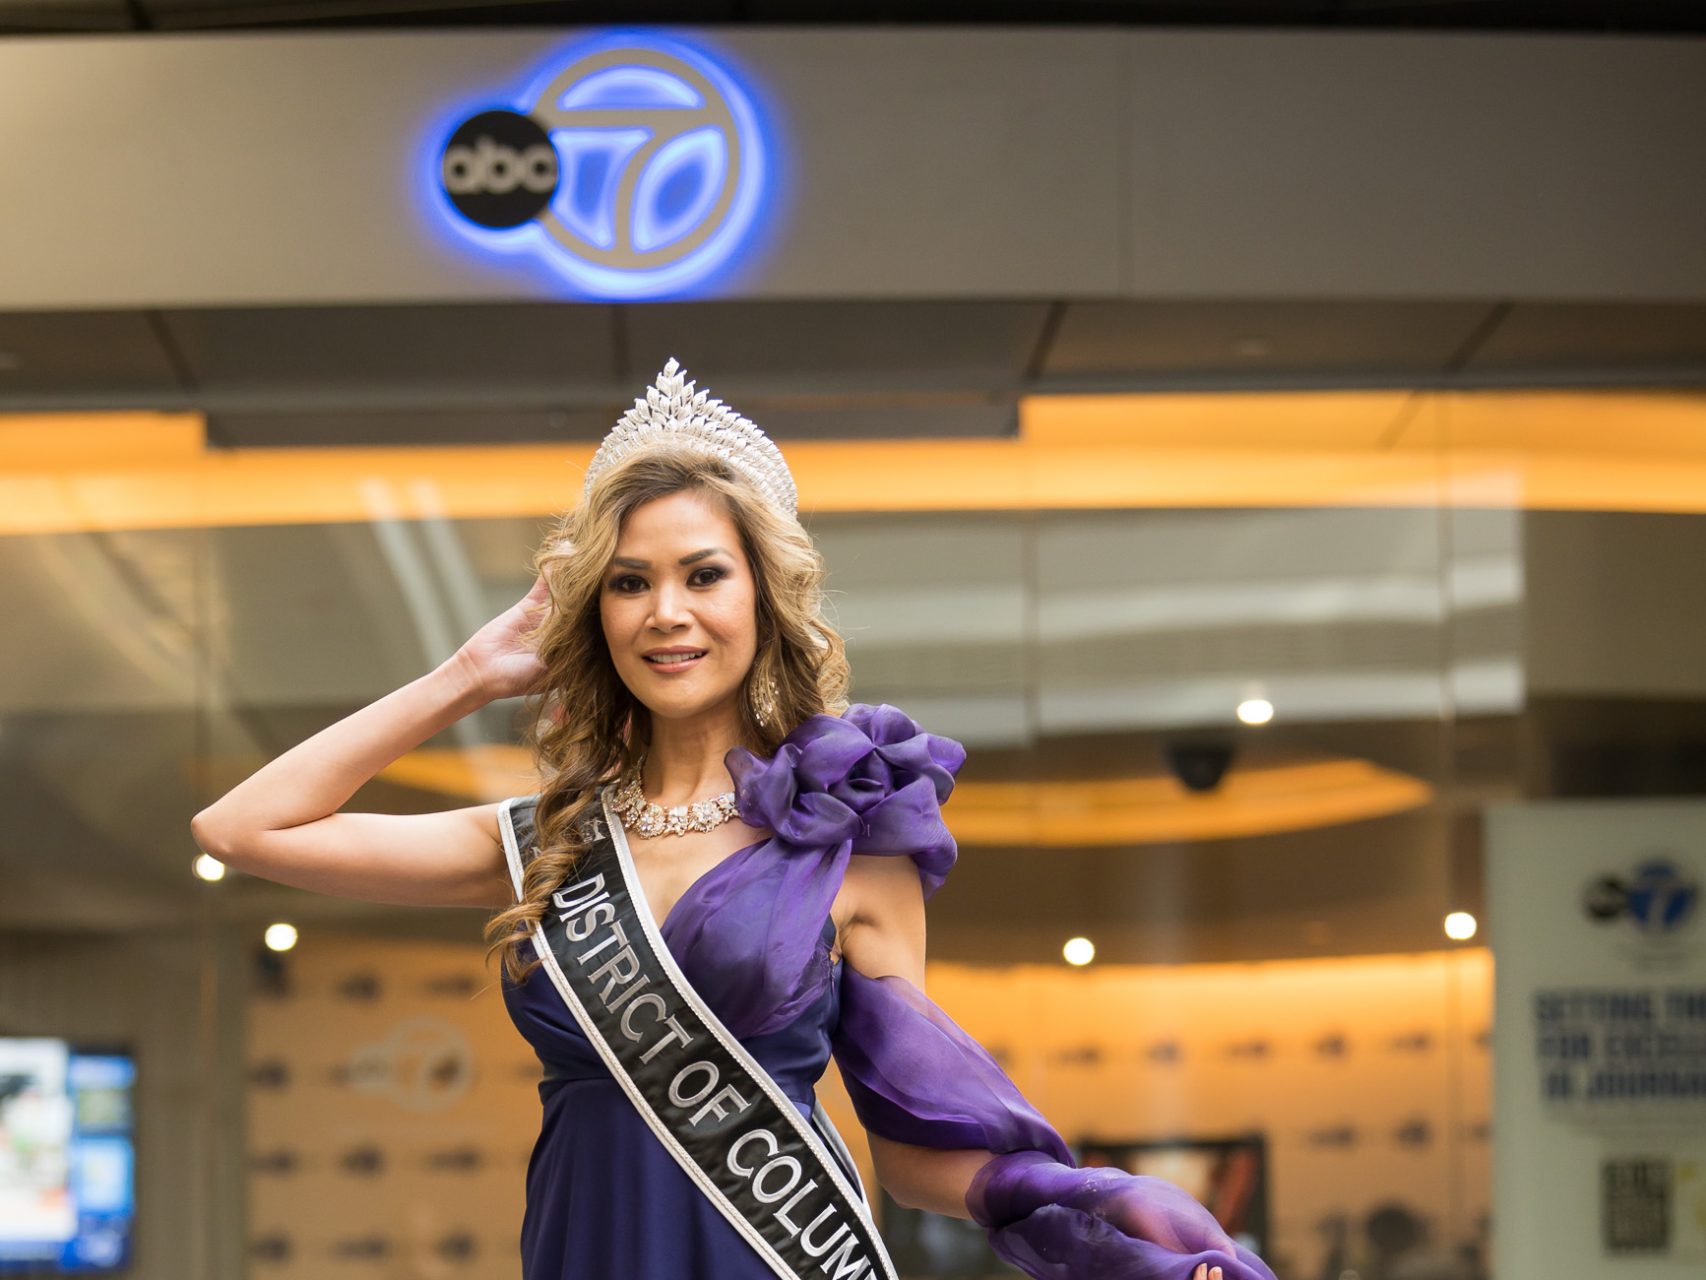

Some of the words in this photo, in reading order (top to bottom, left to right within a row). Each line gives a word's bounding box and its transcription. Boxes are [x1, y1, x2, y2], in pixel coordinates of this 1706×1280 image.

[443, 136, 558, 194] abc
[552, 873, 694, 1065] DISTRICT
[668, 1061, 751, 1127] OF
